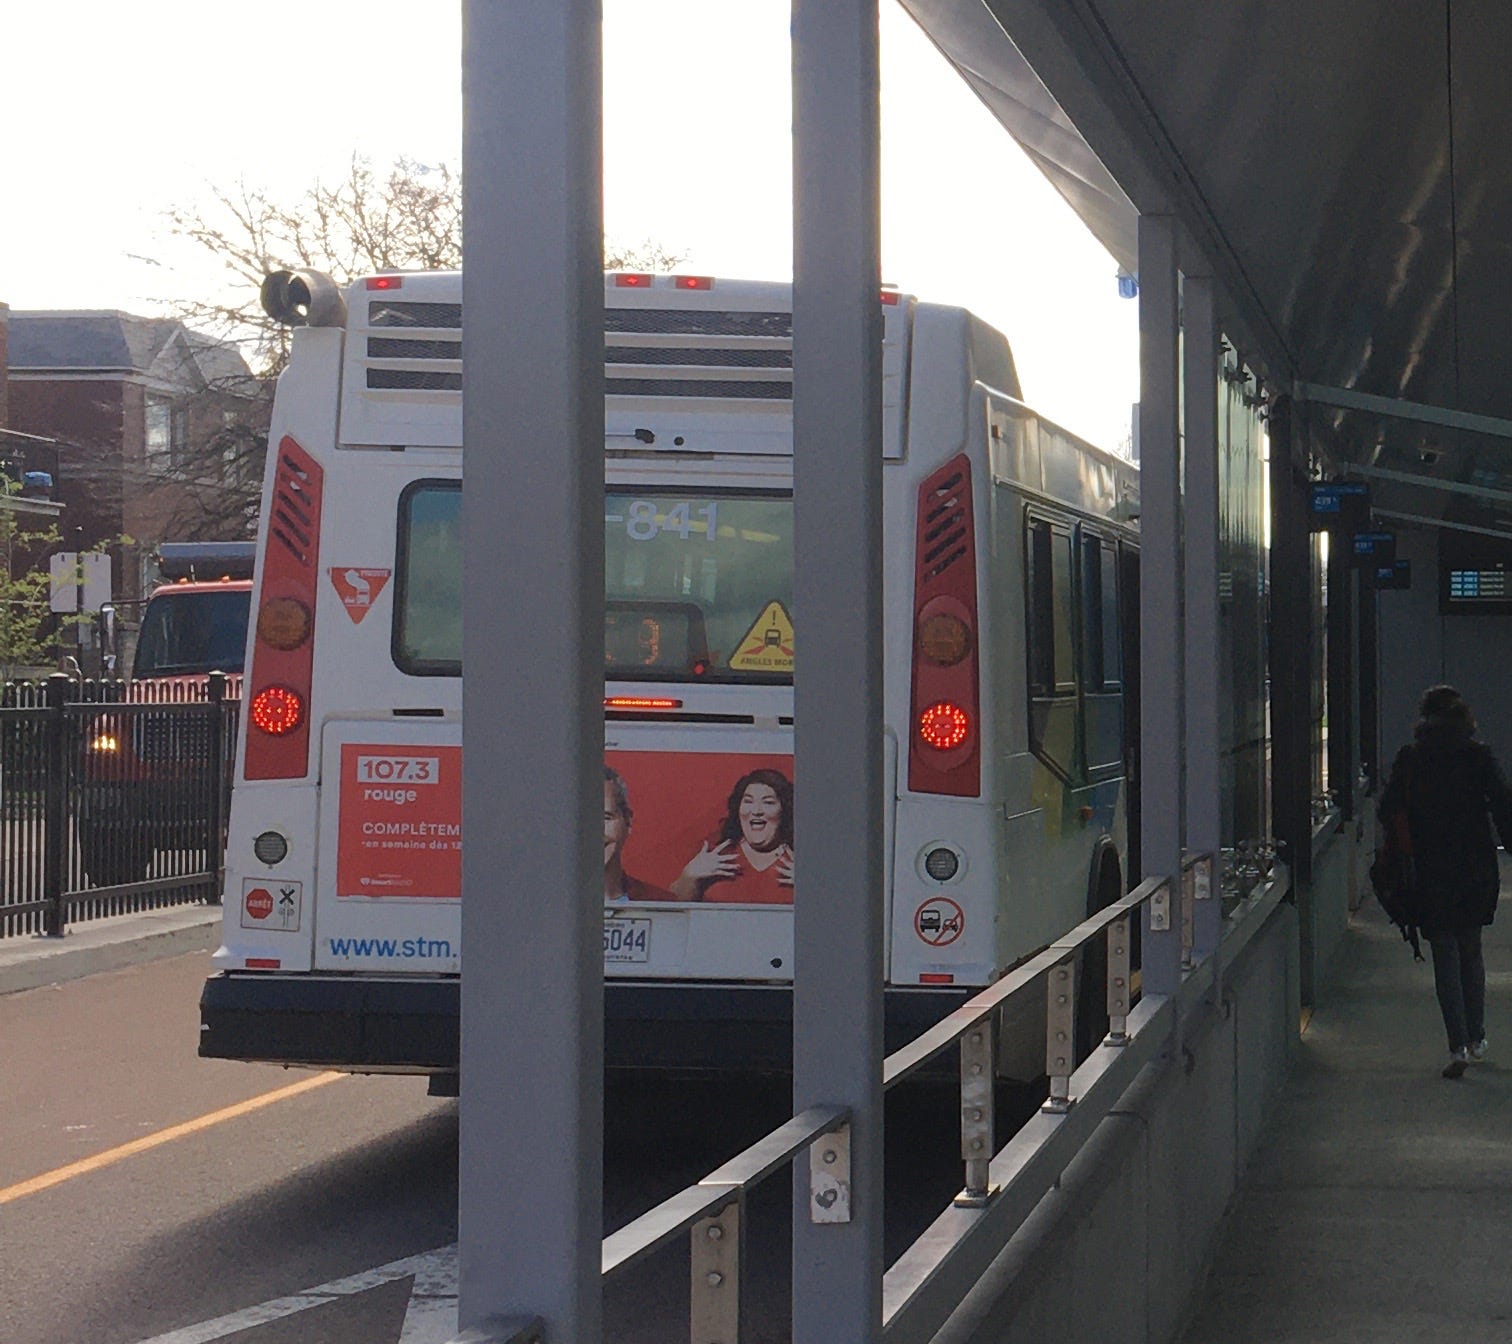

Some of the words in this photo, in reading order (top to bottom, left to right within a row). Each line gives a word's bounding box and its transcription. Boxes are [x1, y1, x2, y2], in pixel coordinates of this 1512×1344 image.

[740, 657, 772, 666] ANGLES
[363, 760, 430, 780] 107.3
[364, 789, 417, 805] rouge
[362, 821, 460, 836] COMPLÈTEM
[382, 840, 426, 849] semaine
[429, 839, 448, 850] dès
[248, 898, 272, 910] ARRÊT
